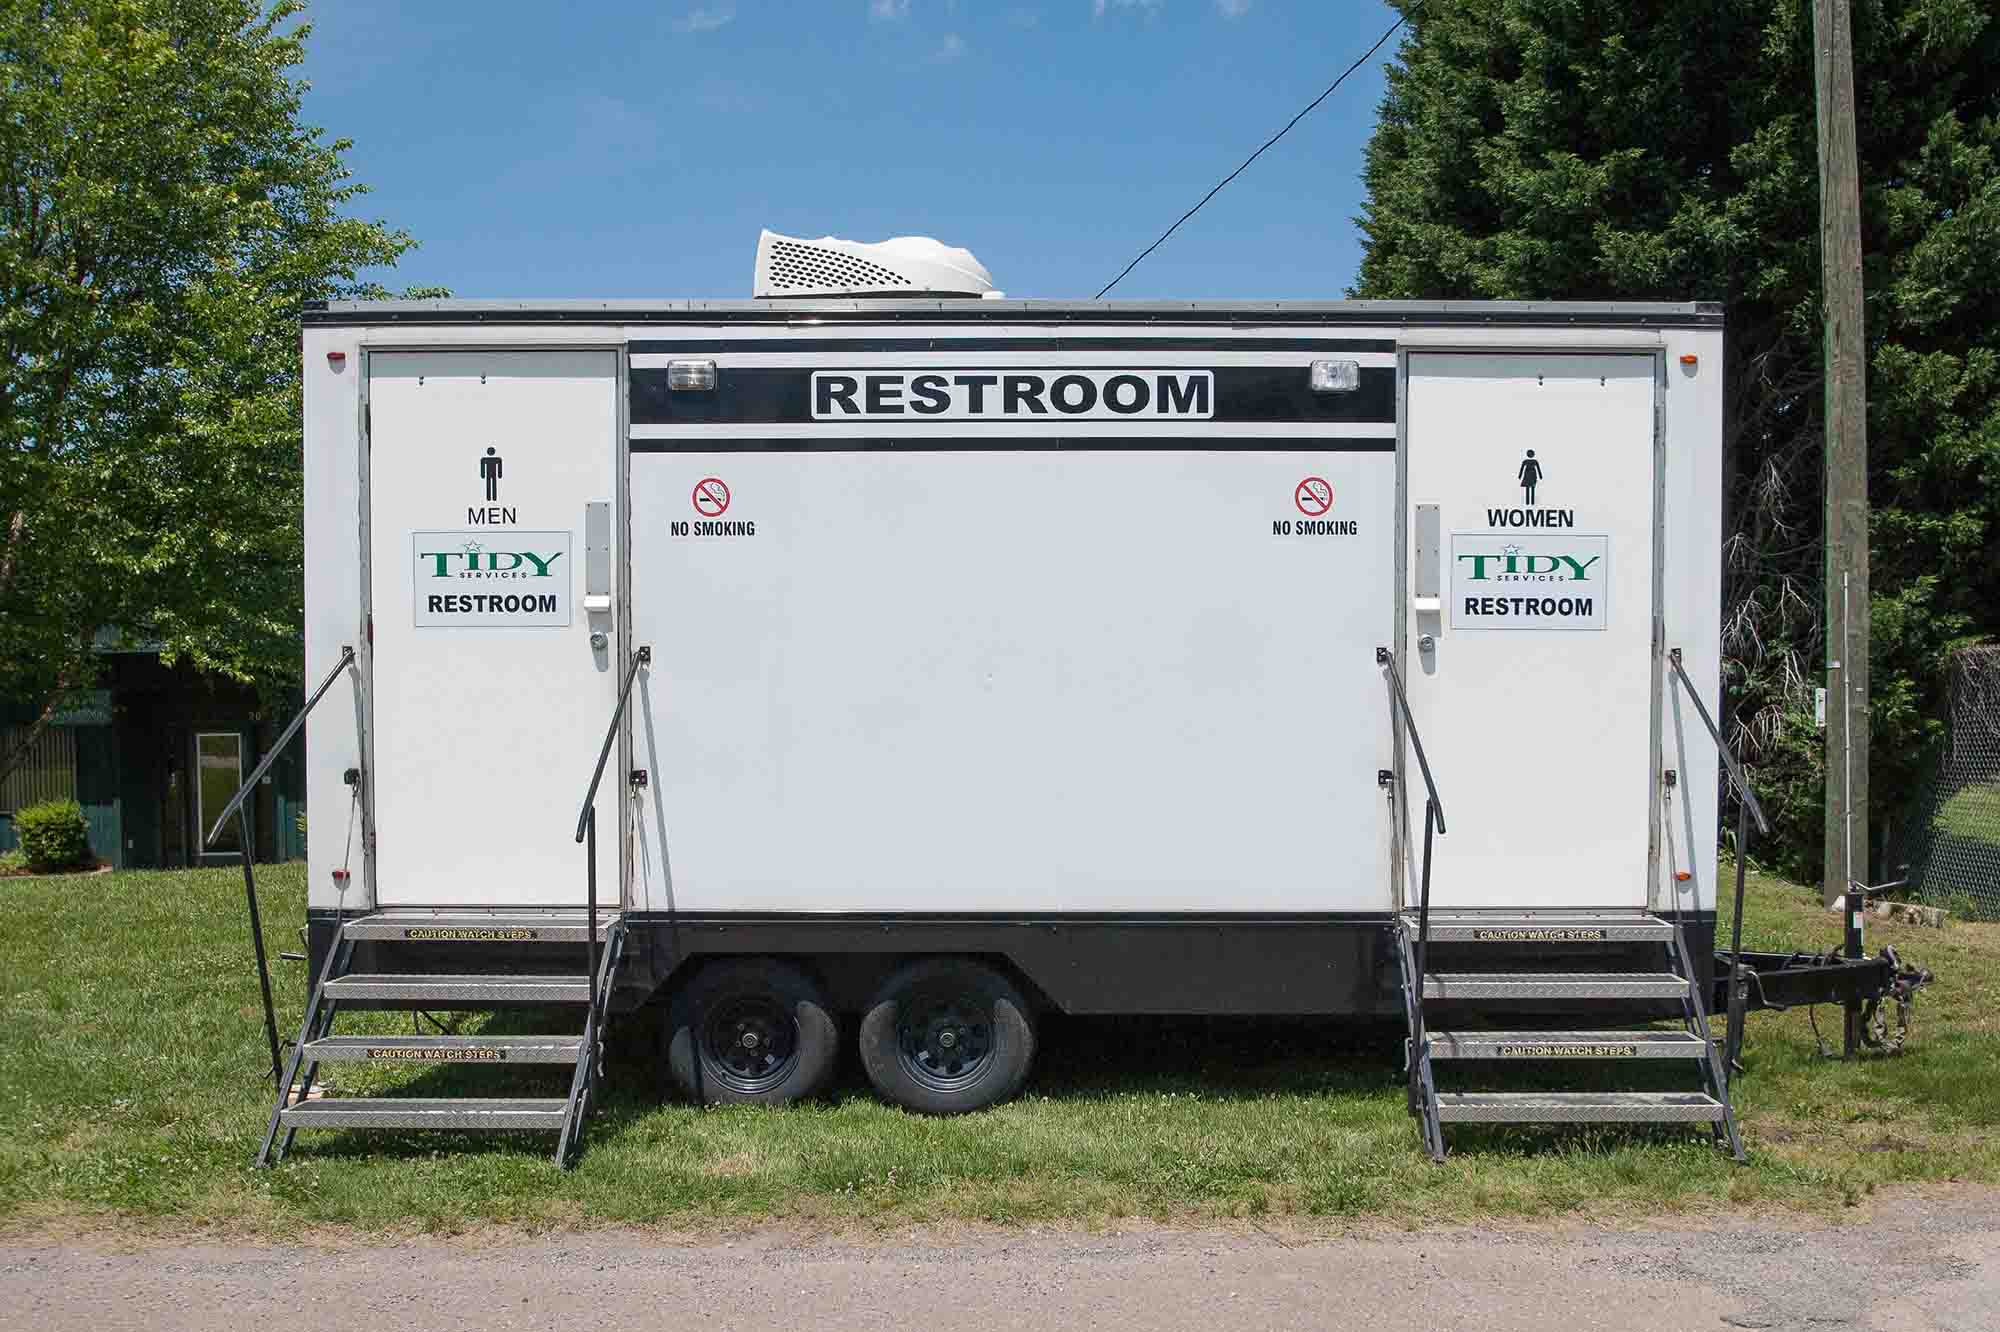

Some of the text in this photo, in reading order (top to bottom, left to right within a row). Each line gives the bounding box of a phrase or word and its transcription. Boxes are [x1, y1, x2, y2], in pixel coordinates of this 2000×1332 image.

[815, 374, 1210, 415] RESTROOM
[468, 507, 517, 525] MEN
[1487, 508, 1574, 528] WOMEN
[671, 521, 755, 537] NO SMOKING
[1272, 520, 1358, 536] NO SMOKING
[420, 549, 563, 578] TIDY
[1457, 552, 1601, 581] TIDY
[459, 571, 527, 579] SERVICES
[428, 594, 557, 613] RESTROOM
[1464, 597, 1593, 616] RESTROOM
[410, 929, 530, 940] CAUTION WATCH STEPS
[1480, 930, 1526, 940] CAUTION
[1528, 930, 1565, 940] WATCH
[373, 1048, 500, 1060] CAUTION WATCH STEPS
[1503, 1045, 1632, 1056] CAUTION WATCH STEPS
